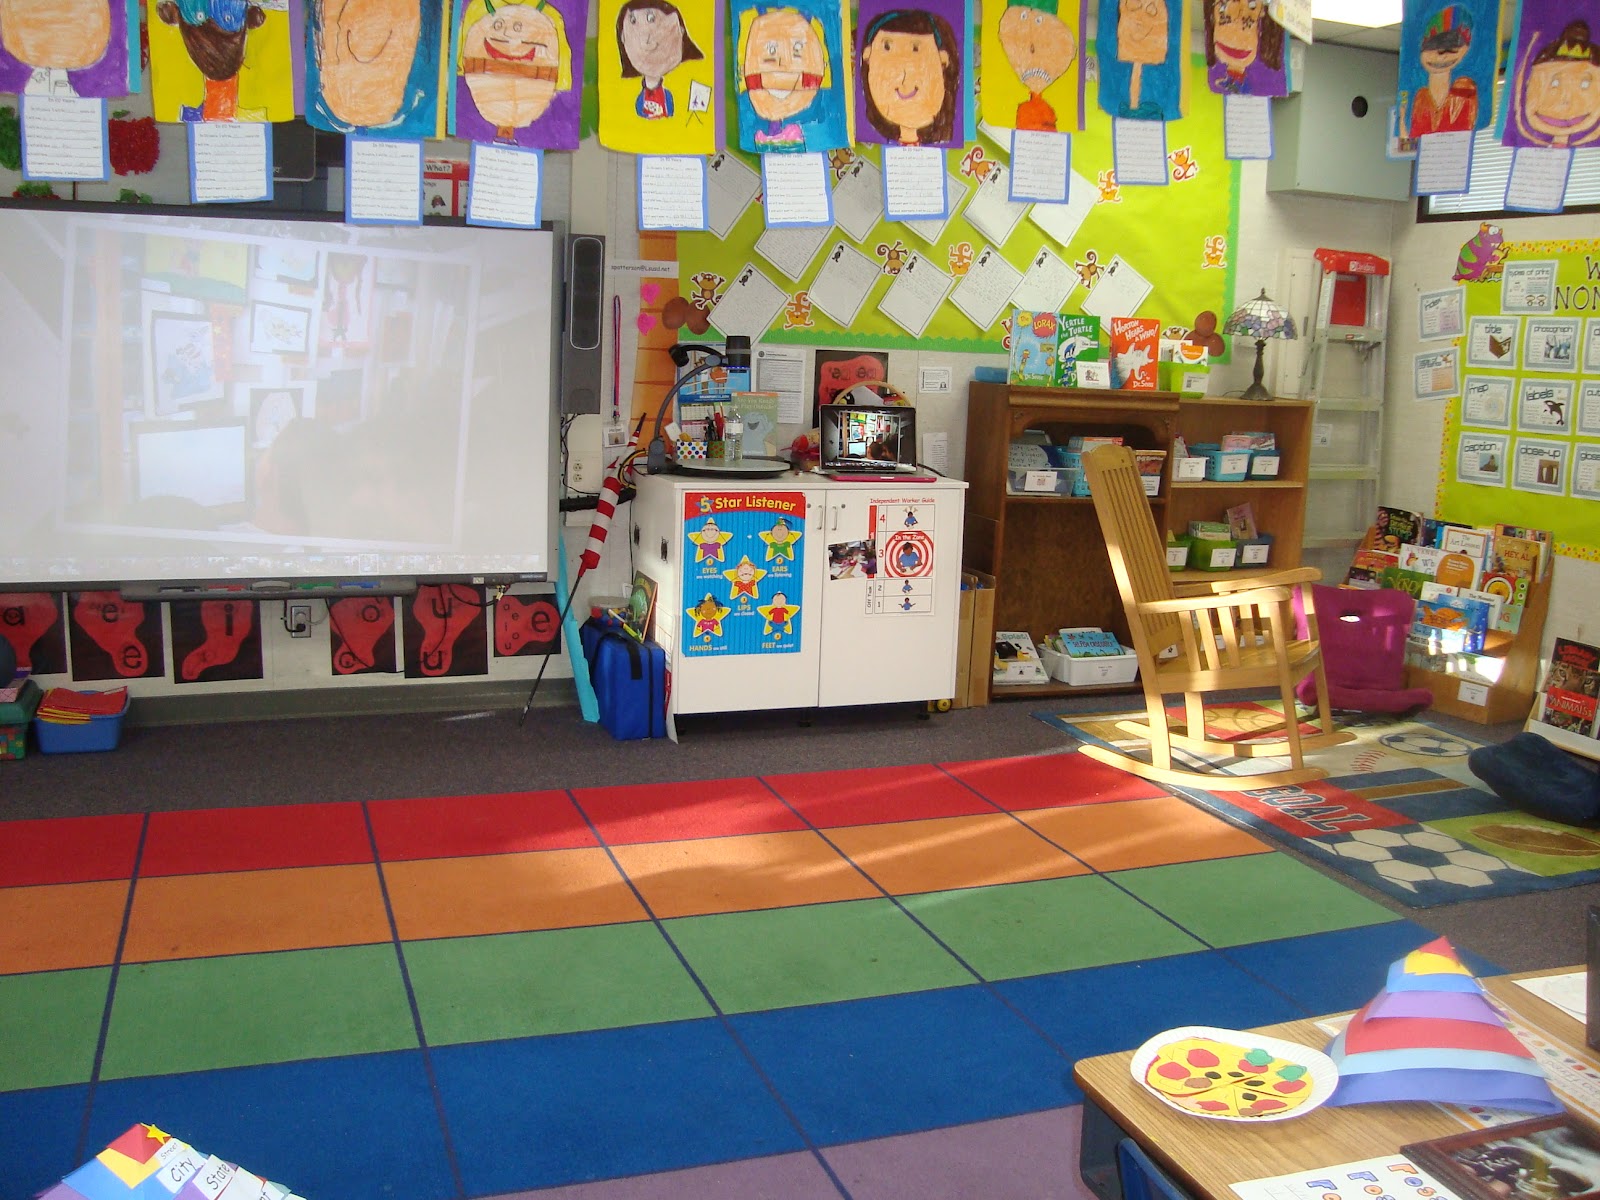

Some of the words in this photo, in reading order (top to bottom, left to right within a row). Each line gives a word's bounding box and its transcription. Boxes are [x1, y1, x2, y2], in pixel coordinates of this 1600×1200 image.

[426, 164, 450, 172] What?
[1034, 318, 1056, 331] LORAX
[1060, 316, 1084, 331] YERTLE
[1068, 325, 1093, 336] TURTLE
[1114, 319, 1139, 336] HORTON
[1484, 324, 1502, 334] title
[1140, 324, 1159, 342] WHO!
[1469, 384, 1488, 395] map
[1526, 388, 1554, 401] labels
[1464, 442, 1498, 452] caption
[1520, 446, 1561, 459] close-up
[700, 497, 710, 512] 5
[715, 497, 742, 509] Star
[746, 496, 796, 511] Listener
[880, 514, 885, 523] 4
[1460, 540, 1480, 549] Lesson
[878, 550, 884, 558] 3
[1521, 553, 1529, 561] AL
[102, 604, 119, 622] e
[224, 604, 234, 636] i
[532, 610, 550, 632] e
[122, 646, 142, 668] e
[424, 650, 442, 670] u
[160, 1142, 178, 1160] Street
[170, 1157, 196, 1182] City
[206, 1163, 230, 1190] State
